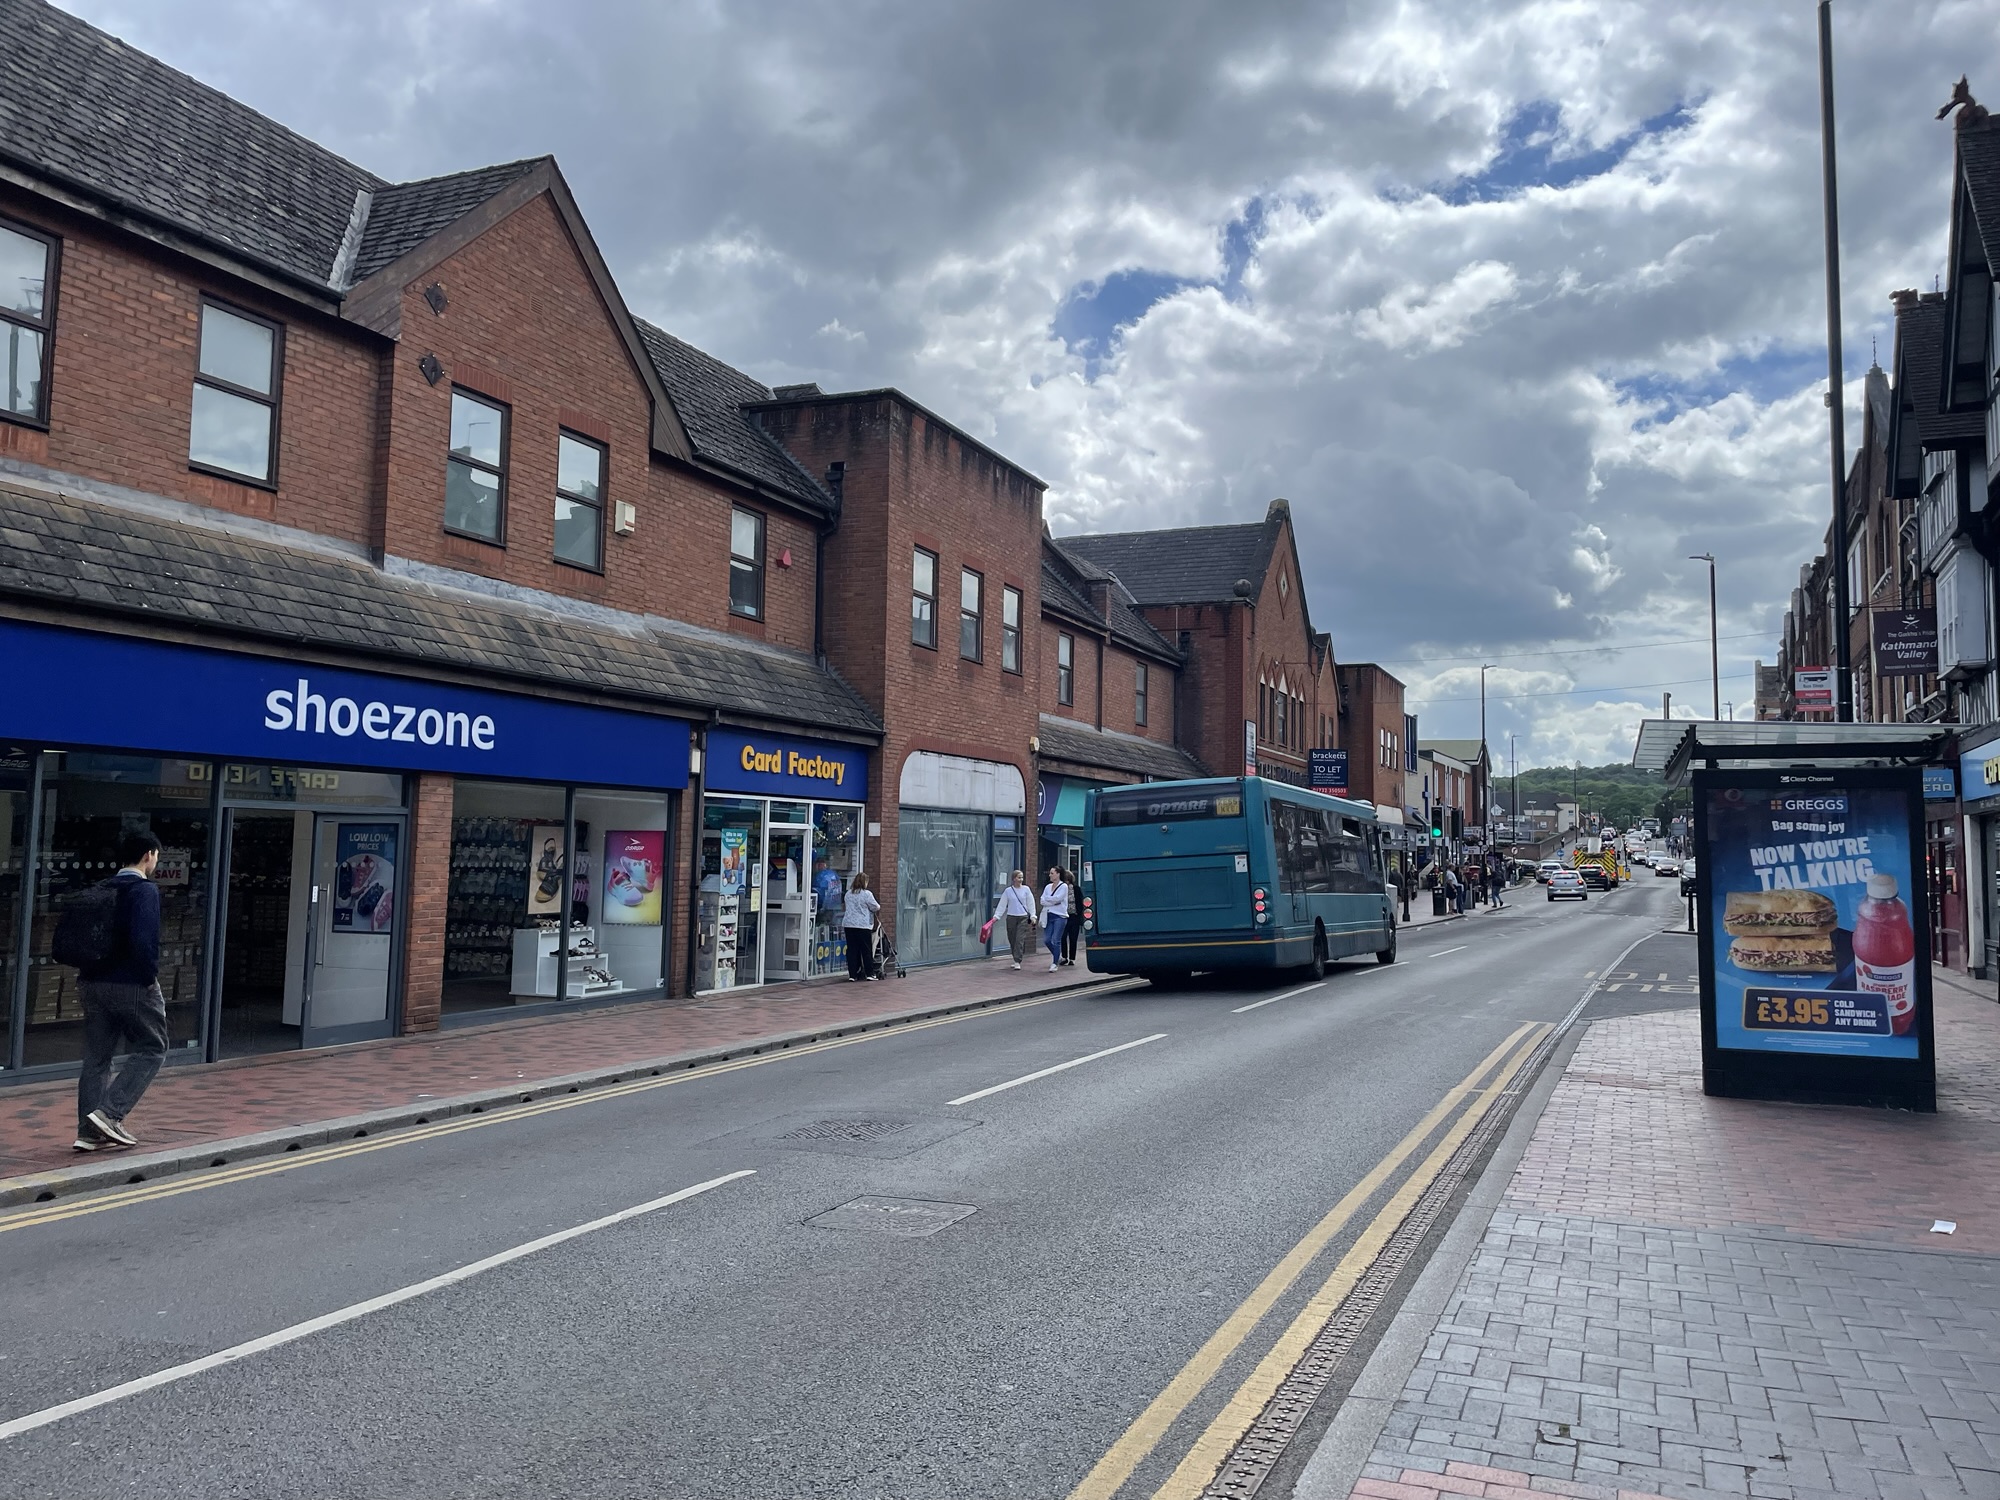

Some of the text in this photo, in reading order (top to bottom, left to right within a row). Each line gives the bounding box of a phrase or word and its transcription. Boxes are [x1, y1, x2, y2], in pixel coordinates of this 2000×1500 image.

[1880, 640, 1938, 650] Kathmand
[1897, 650, 1928, 660] Valley
[265, 678, 495, 750] shoezone
[1312, 751, 1347, 759] bracketts
[741, 745, 845, 785] Card Factory
[1313, 765, 1341, 773] TO LET
[1983, 756, 2000, 785] CAF
[1923, 783, 1952, 792] ERO
[1147, 799, 1208, 816] OPTARE
[1785, 799, 1844, 810] GREGGS
[1771, 820, 1845, 834] Bag some joy
[349, 833, 389, 842] LOW LOW
[1750, 836, 1871, 866] NOW YOU'RE
[155, 869, 181, 879] SAVE
[1754, 857, 1875, 891] TALKING
[1861, 982, 1908, 994] RASPBERRY
[1834, 1000, 1854, 1008] COLD
[1834, 1009, 1876, 1018] SANDWICH
[1835, 1018, 1877, 1027] ANY DRINK
